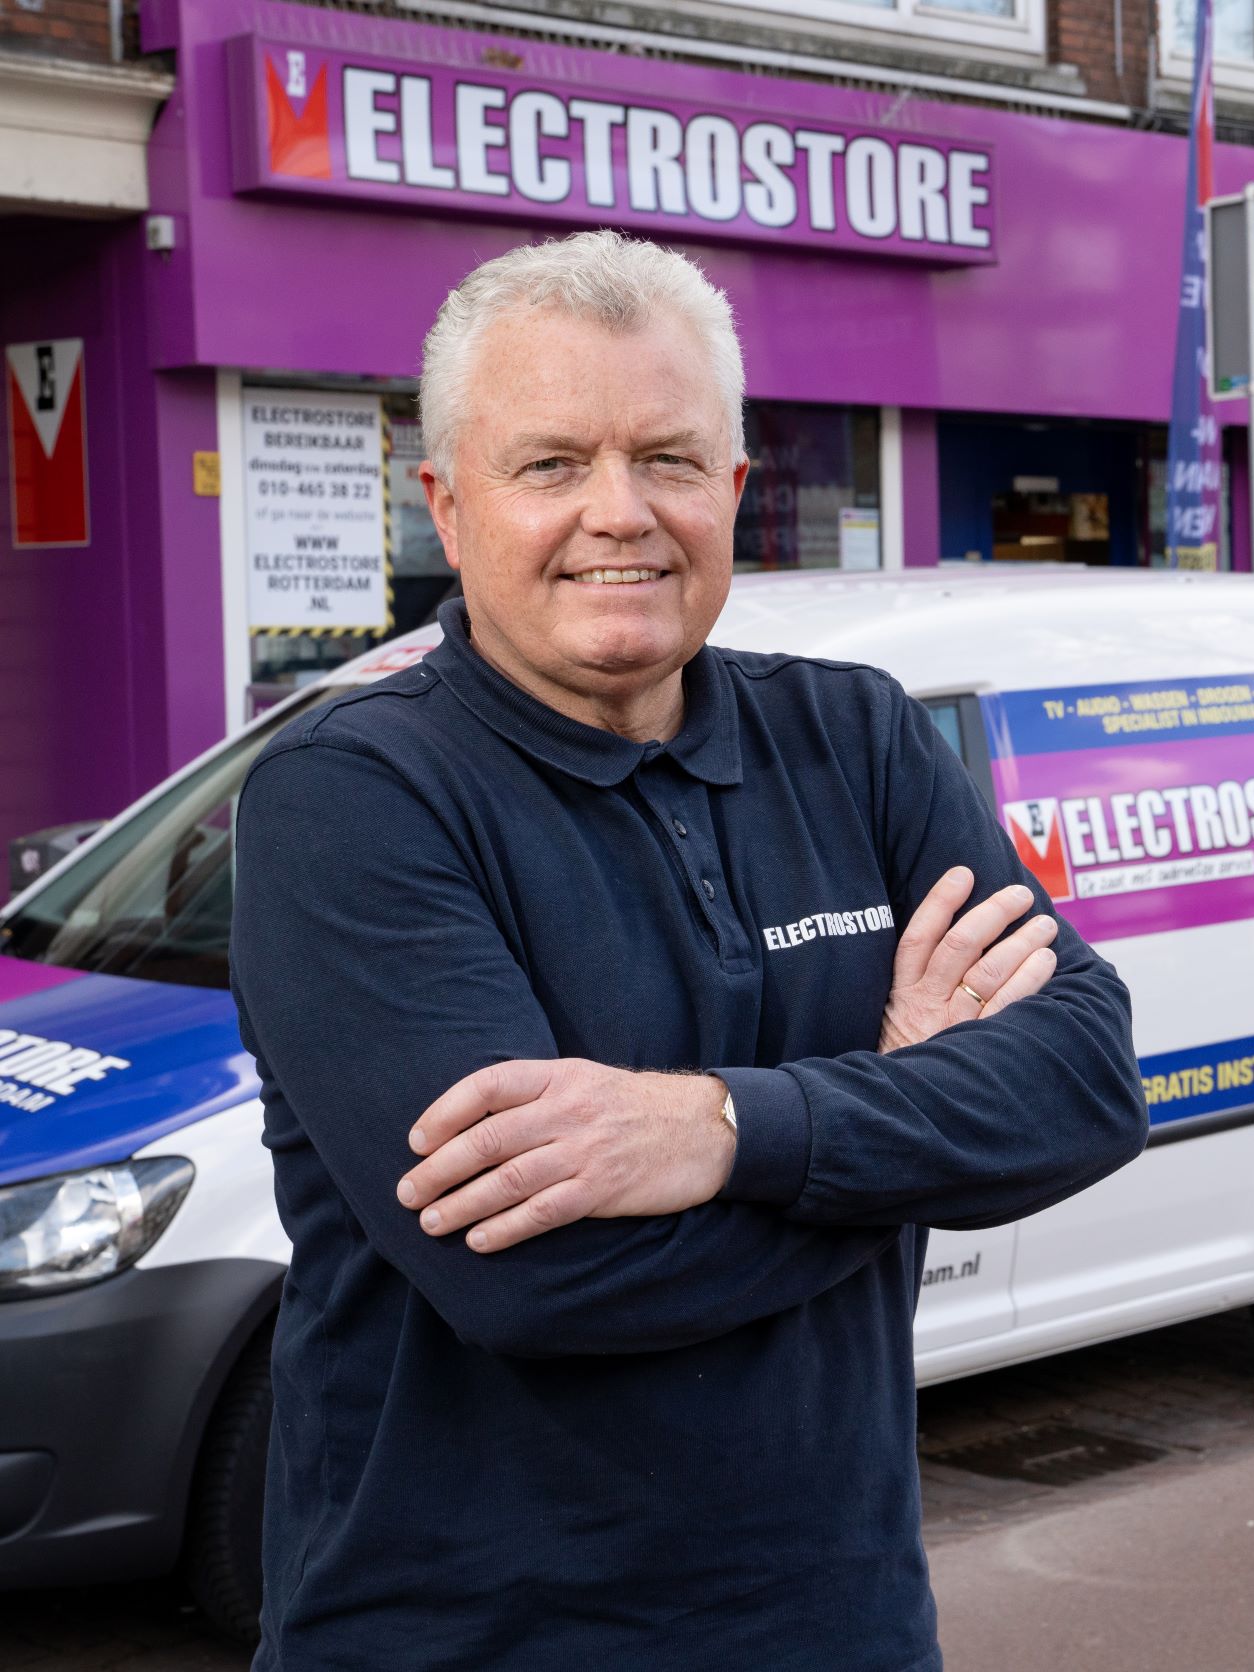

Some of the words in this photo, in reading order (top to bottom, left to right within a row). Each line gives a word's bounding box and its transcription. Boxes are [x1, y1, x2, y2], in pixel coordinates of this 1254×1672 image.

[286, 51, 306, 97] E
[342, 66, 991, 248] ELECTROSTORE
[36, 345, 56, 411] E
[251, 405, 377, 428] ELECTROSTORE
[263, 432, 365, 450] BEREIKBAAR
[353, 483, 371, 498] 22
[254, 554, 381, 574] ELECTROSTORE
[267, 574, 372, 592] ROTTERDAM
[1043, 700, 1065, 720] TV
[1027, 803, 1045, 837] E
[1142, 1065, 1214, 1105] GRATIS
